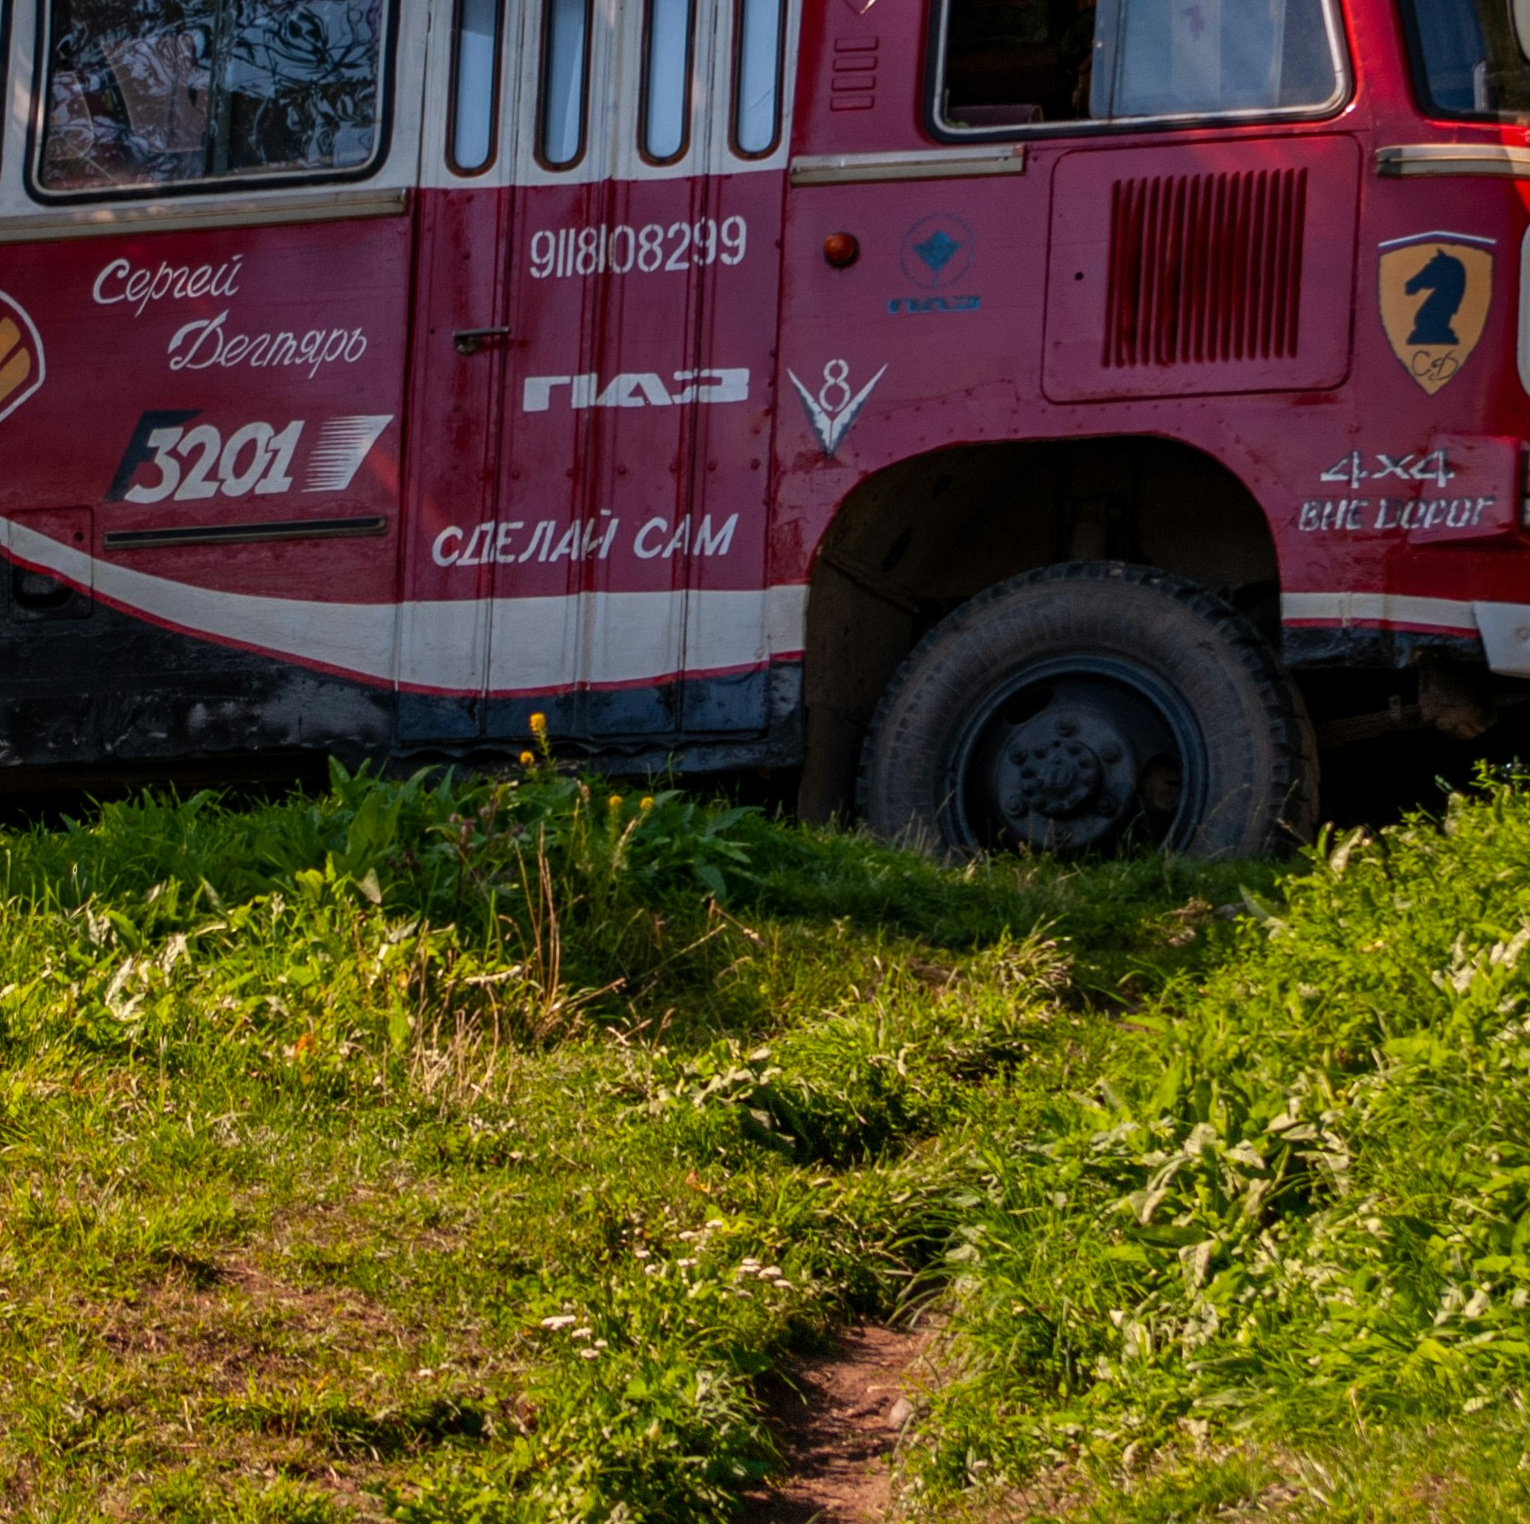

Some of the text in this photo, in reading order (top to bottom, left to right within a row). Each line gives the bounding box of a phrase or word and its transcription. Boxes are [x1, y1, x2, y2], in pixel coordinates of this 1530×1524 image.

[92, 253, 244, 318] Сергей
[167, 309, 367, 380] Дегтярь
[522, 367, 750, 413] ПАЗ
[431, 508, 739, 567] СДЕЛАЙ САМ
[1298, 499, 1369, 531] ВНЕ
